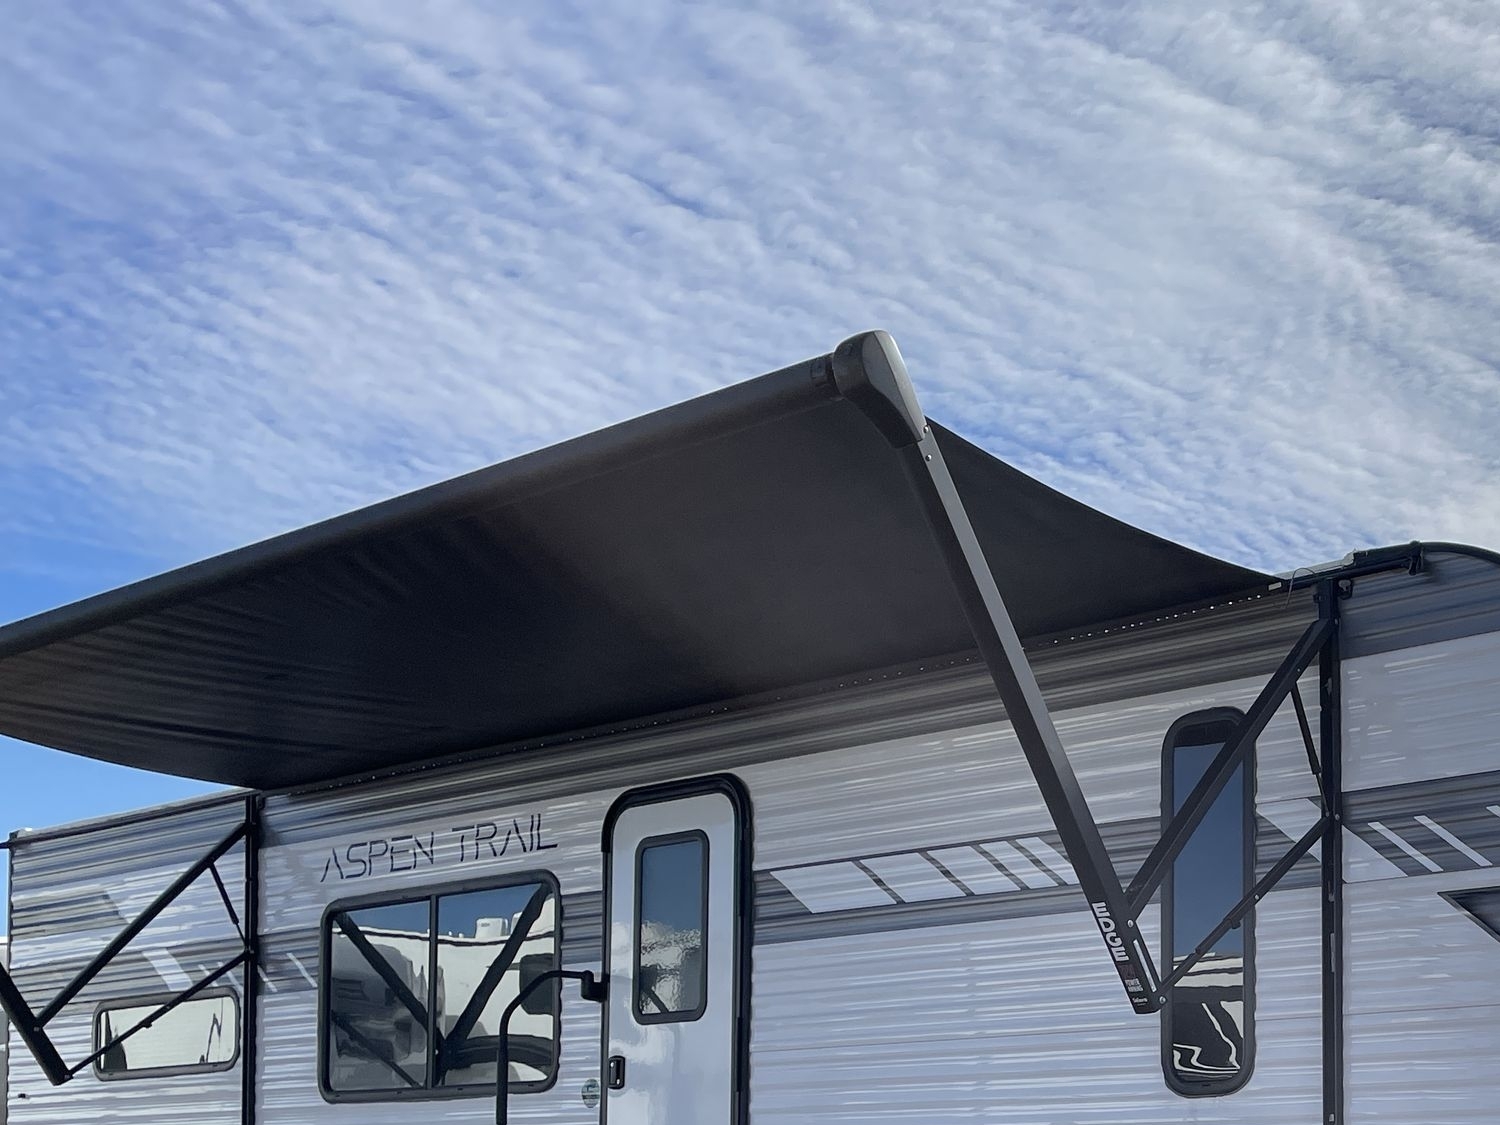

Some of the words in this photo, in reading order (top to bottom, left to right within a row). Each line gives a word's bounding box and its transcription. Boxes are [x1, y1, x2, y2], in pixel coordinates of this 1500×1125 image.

[320, 831, 434, 883] ASPEN
[452, 813, 558, 862] TRAIL
[1091, 901, 1130, 962] EDGE
